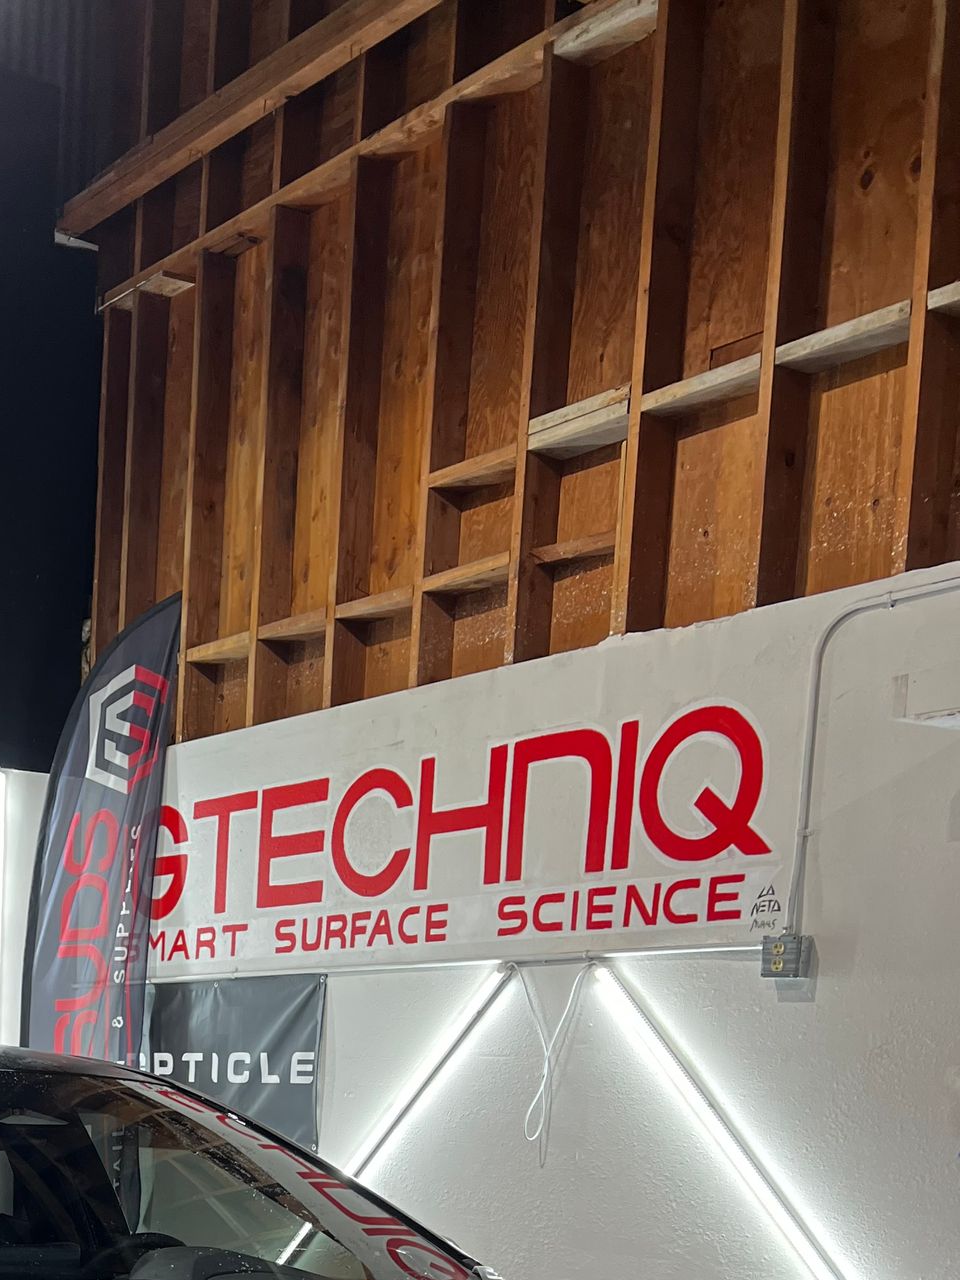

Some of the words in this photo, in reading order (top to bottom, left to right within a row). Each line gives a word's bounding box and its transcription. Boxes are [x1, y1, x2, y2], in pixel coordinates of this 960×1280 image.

[137, 705, 772, 922] GTECHNIQ
[275, 904, 449, 955] SURFACE
[497, 874, 746, 938] SCIENCE
[750, 899, 781, 917] NETA
[757, 884, 775, 899] LA
